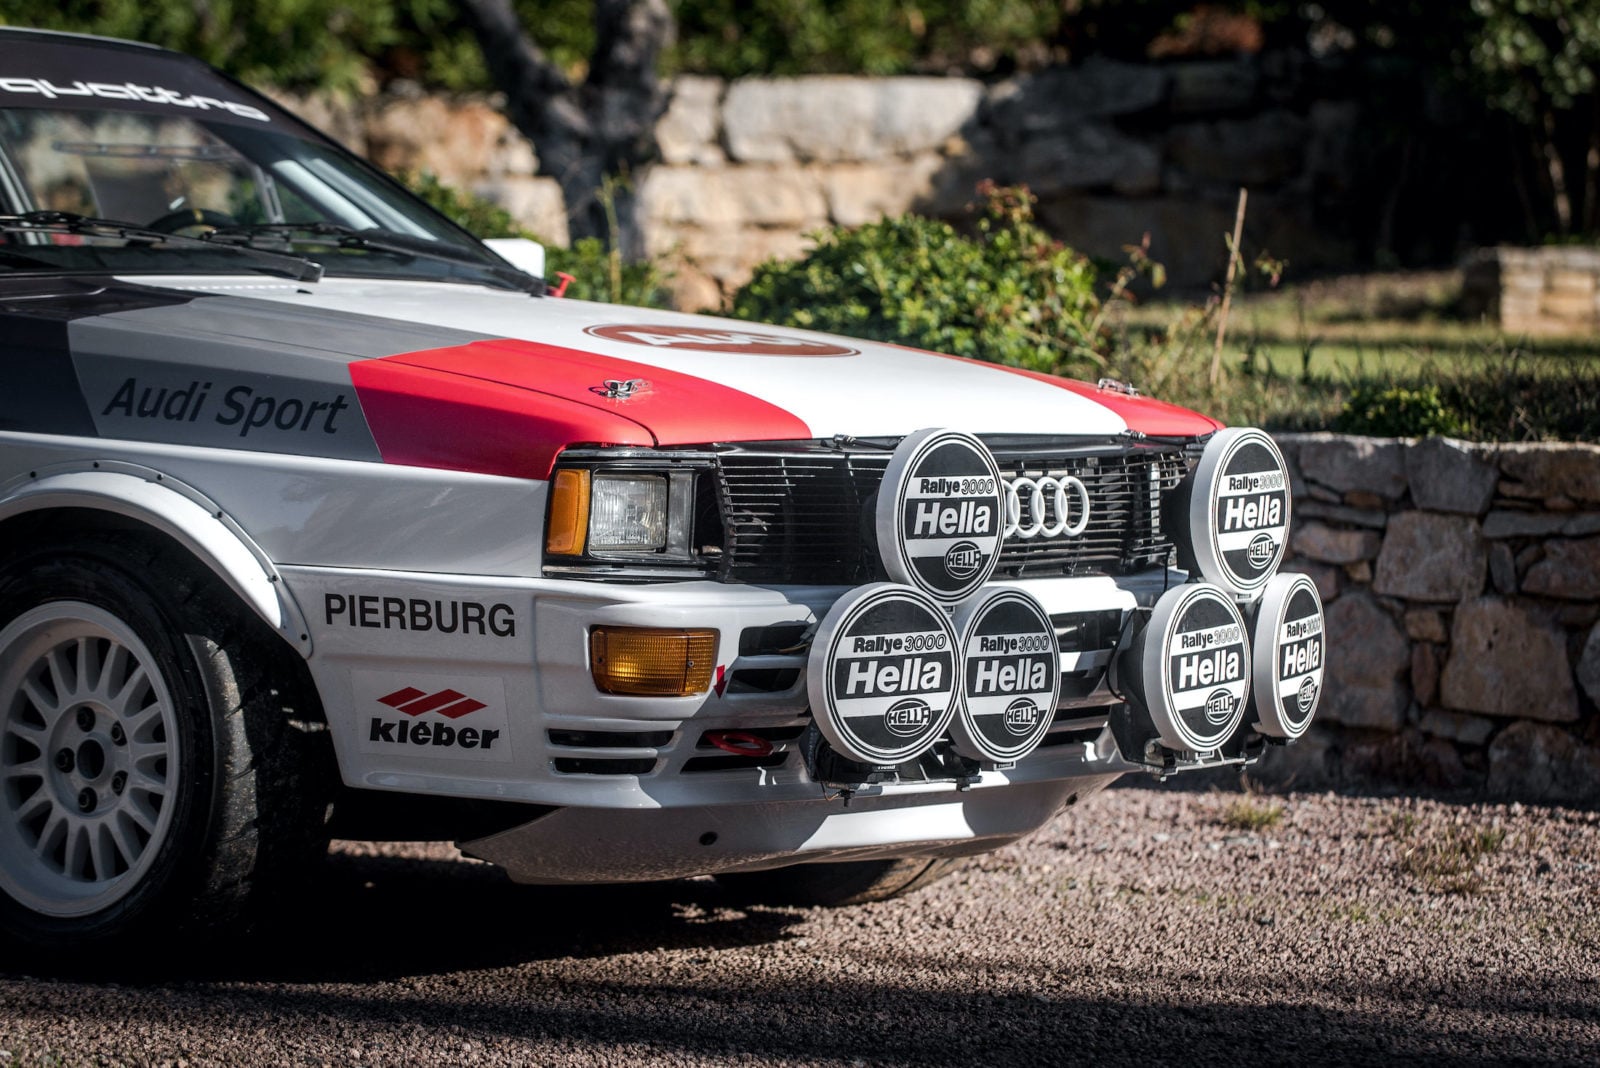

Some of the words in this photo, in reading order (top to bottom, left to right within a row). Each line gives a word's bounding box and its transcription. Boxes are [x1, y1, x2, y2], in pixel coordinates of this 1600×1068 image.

[0, 77, 271, 122] quattro
[102, 377, 213, 422] Audi
[215, 385, 348, 437] Sport
[920, 478, 960, 496] Rallye
[961, 478, 994, 495] 3000
[1229, 475, 1259, 492] Rallye
[1259, 473, 1283, 490] 3000
[914, 501, 991, 535] Hella
[1224, 494, 1281, 530] Hella
[947, 551, 982, 567] HELLA
[1249, 541, 1273, 556] HELLA
[325, 593, 516, 637] PIERBURG
[1181, 632, 1214, 649] Rallye
[1214, 626, 1240, 646] 3000
[1286, 622, 1307, 638] Rallye
[853, 635, 903, 653] Rallye
[903, 633, 947, 652] 3000
[980, 635, 1018, 653] Rallye
[1018, 634, 1050, 651] 3000
[1283, 638, 1320, 677] Hella
[846, 658, 942, 694] Hella
[976, 658, 1046, 693] Hella
[1178, 649, 1239, 690] Hella
[888, 706, 930, 725] HELLA
[1007, 708, 1038, 723] HELLA
[1207, 696, 1234, 713] HELLA
[369, 717, 500, 749] kléber
